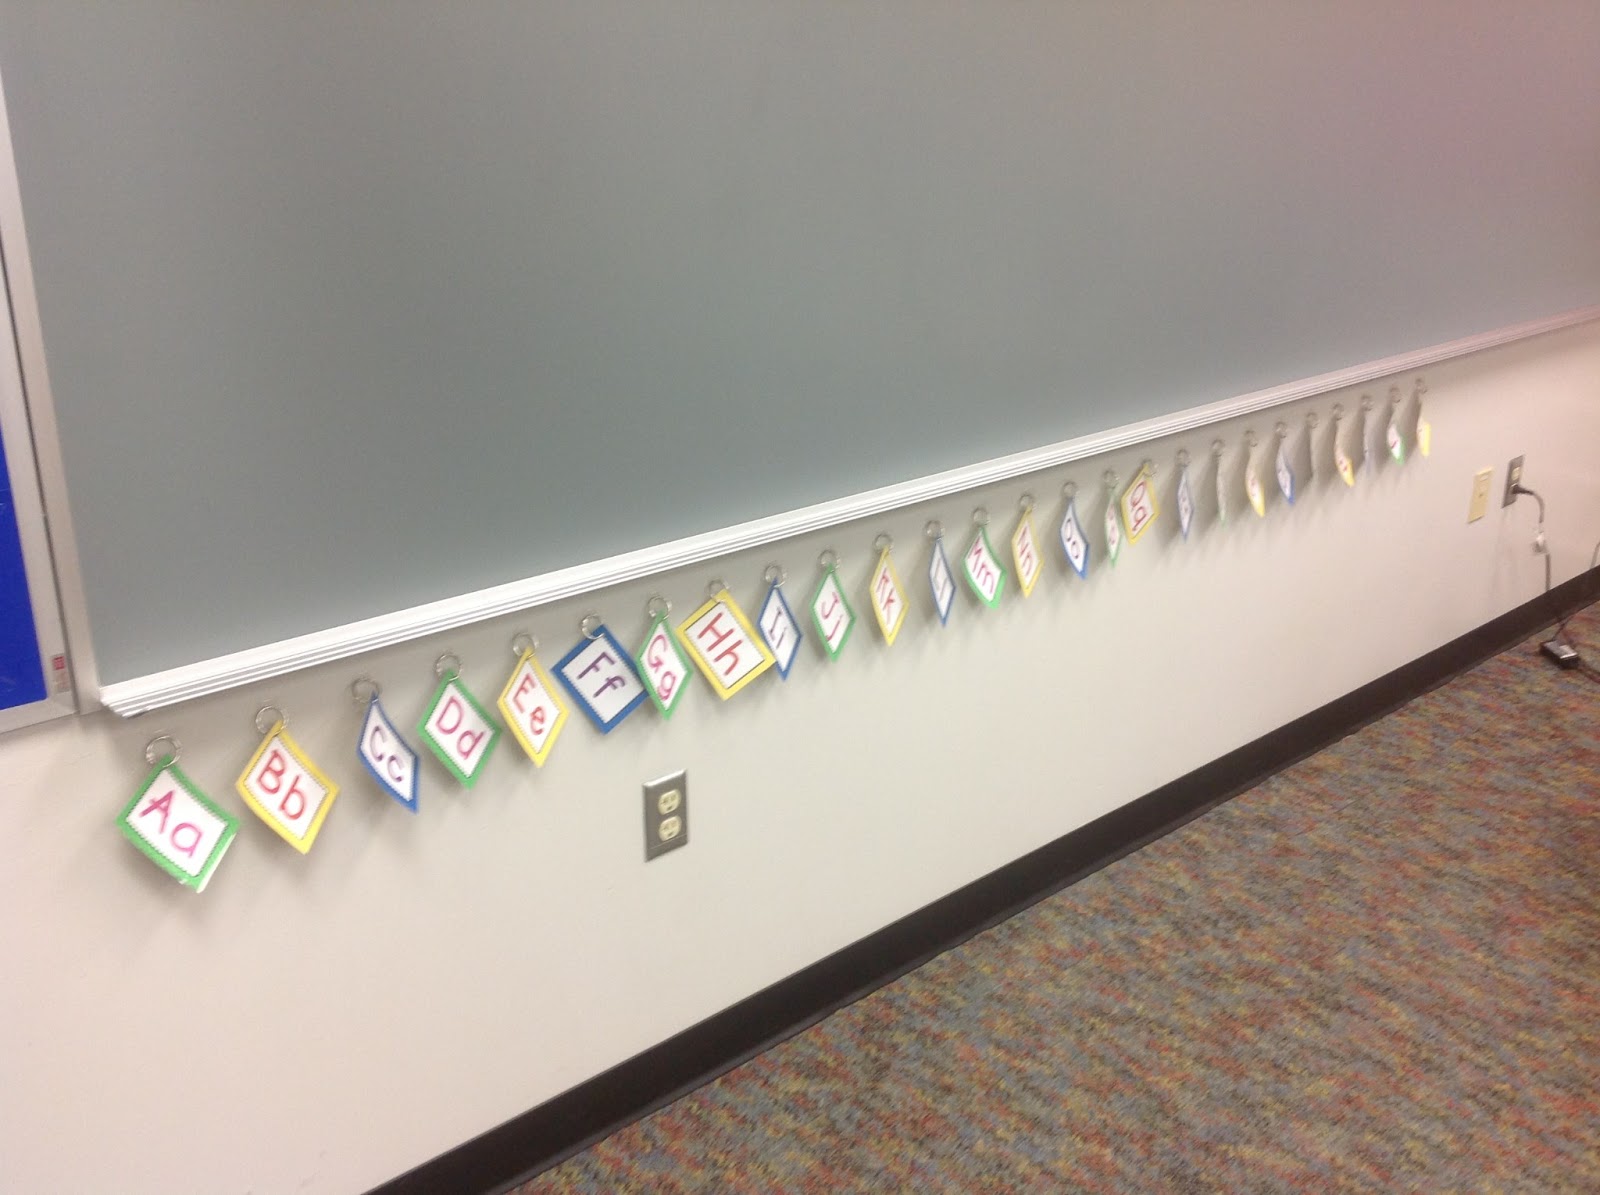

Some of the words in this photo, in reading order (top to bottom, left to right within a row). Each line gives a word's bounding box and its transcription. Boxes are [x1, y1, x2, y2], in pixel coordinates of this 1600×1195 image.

[1130, 480, 1147, 531] Qq
[576, 651, 626, 698] Ff
[647, 634, 677, 700] Gg
[697, 611, 744, 676] Hh
[436, 696, 485, 760] Dd
[512, 673, 547, 736] Ee
[256, 749, 306, 820] Bb
[370, 726, 405, 783] Cc
[139, 790, 204, 859] Aa
